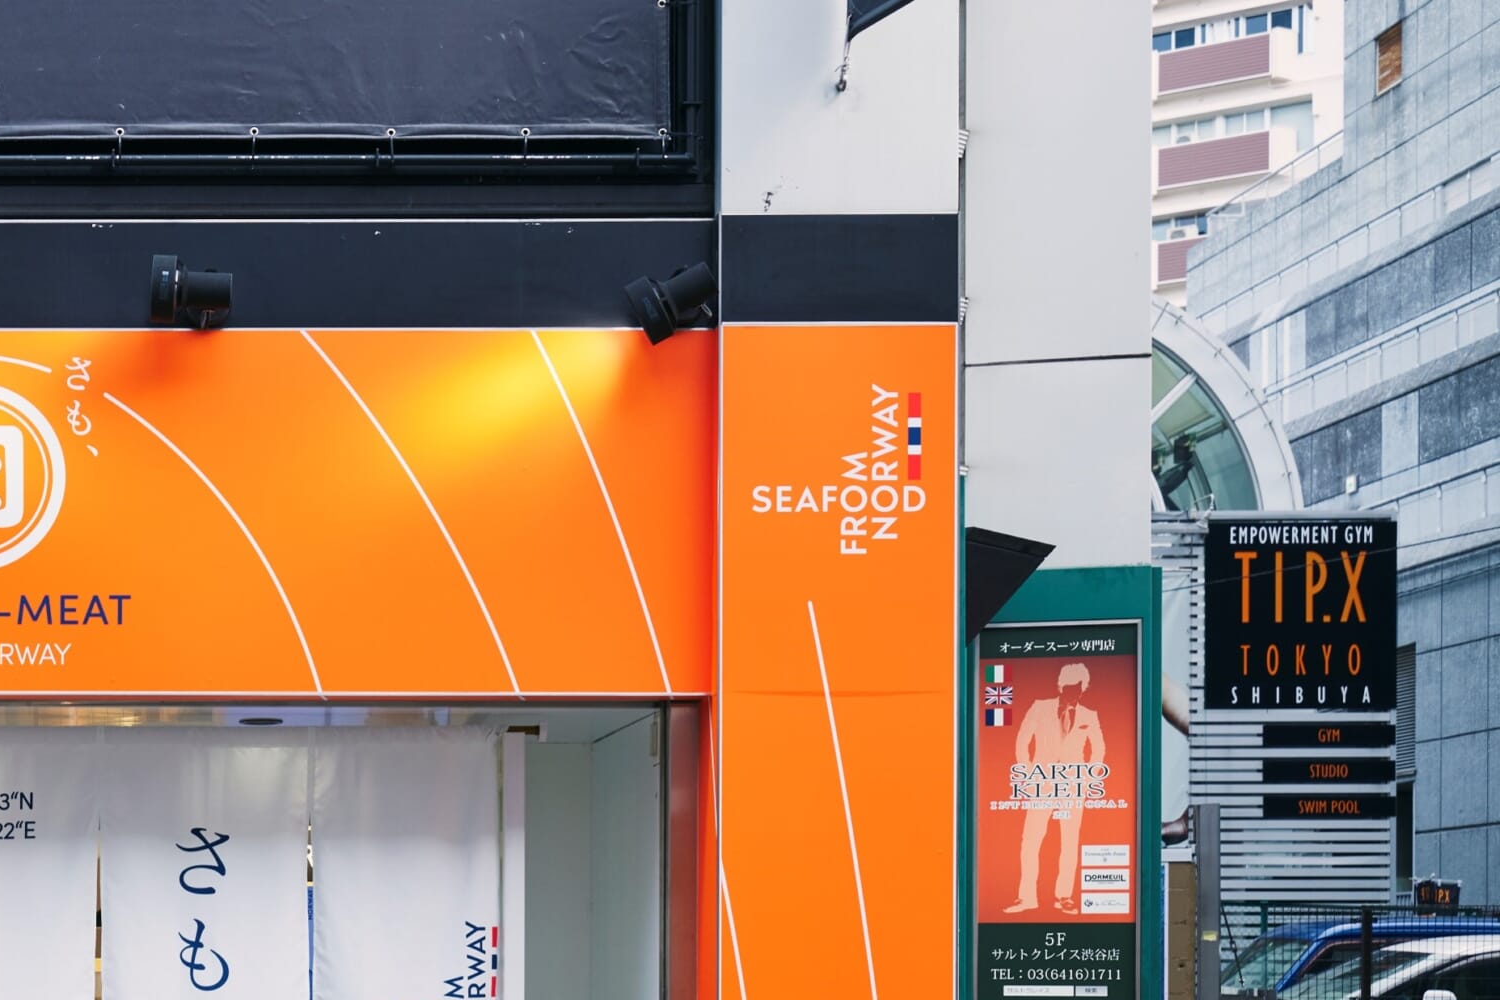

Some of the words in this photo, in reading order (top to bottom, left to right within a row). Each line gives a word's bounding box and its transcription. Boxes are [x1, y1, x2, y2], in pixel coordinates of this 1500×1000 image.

[871, 383, 899, 539] NORWAY
[751, 485, 926, 513] SEAFOOD
[840, 452, 868, 554] FROM
[1230, 526, 1338, 544] EMPOWERMENT
[1345, 526, 1373, 544] GYM
[999, 639, 1115, 653] オーダースーツ専門店
[1240, 644, 1361, 676] TOKYO
[1231, 686, 1371, 704] SHIBUYA
[1318, 729, 1340, 742] GYM
[1010, 763, 1109, 781] SARTO
[1309, 765, 1348, 778] STUDIO
[1010, 782, 1106, 799] KLEIS
[990, 801, 1128, 810] INTERNATIONAL
[1299, 800, 1327, 814] SWIM
[1331, 800, 1360, 814] POOL
[1045, 932, 1066, 946] 5F
[991, 949, 1120, 961] サルトクレイス渋谷店
